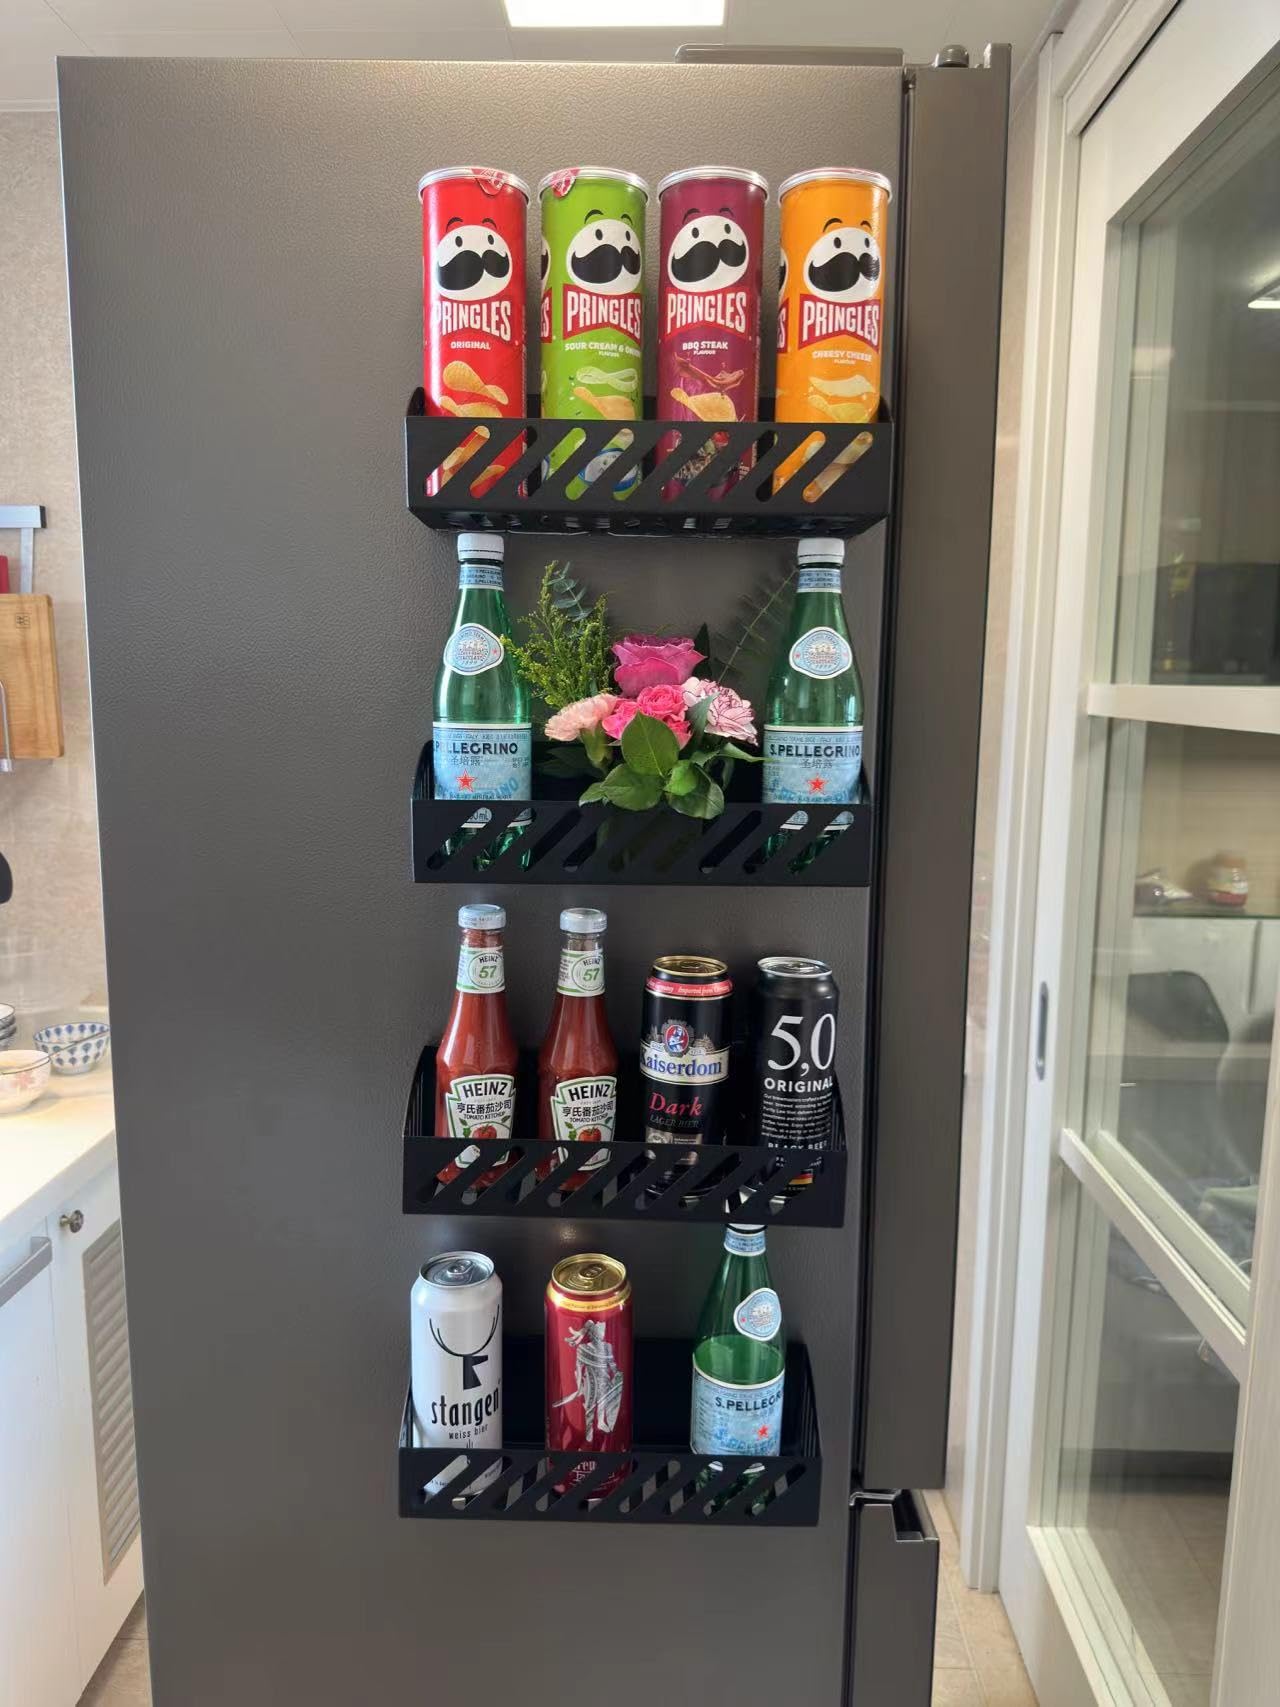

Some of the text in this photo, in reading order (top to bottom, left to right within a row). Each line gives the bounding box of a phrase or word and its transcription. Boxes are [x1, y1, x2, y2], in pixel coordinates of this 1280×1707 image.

[566, 290, 641, 339] PRINGLES
[667, 291, 746, 334] PRINGLES
[802, 300, 879, 346] PRINGLES
[450, 340, 491, 350] ORIGINAL
[564, 342, 587, 351] SOUR
[588, 342, 617, 351] CREAM
[682, 341, 728, 351] BBQ STEAK
[479, 955, 499, 964] HEINZ
[479, 965, 497, 978] 57
[582, 967, 600, 982] 57
[767, 1013, 836, 1077] 5,0
[462, 1081, 508, 1098] HEINZ
[568, 1084, 610, 1101] HEINZ
[764, 1076, 833, 1093] ORIGINAL
[457, 1099, 511, 1114] 亨氏番茄沙司
[562, 1101, 613, 1117] 亨氏番茄沙司
[649, 1091, 703, 1116] Dark
[485, 1111, 505, 1120] KETCHUP
[431, 1387, 499, 1427] stangen
[449, 1424, 488, 1440] weiss bier
